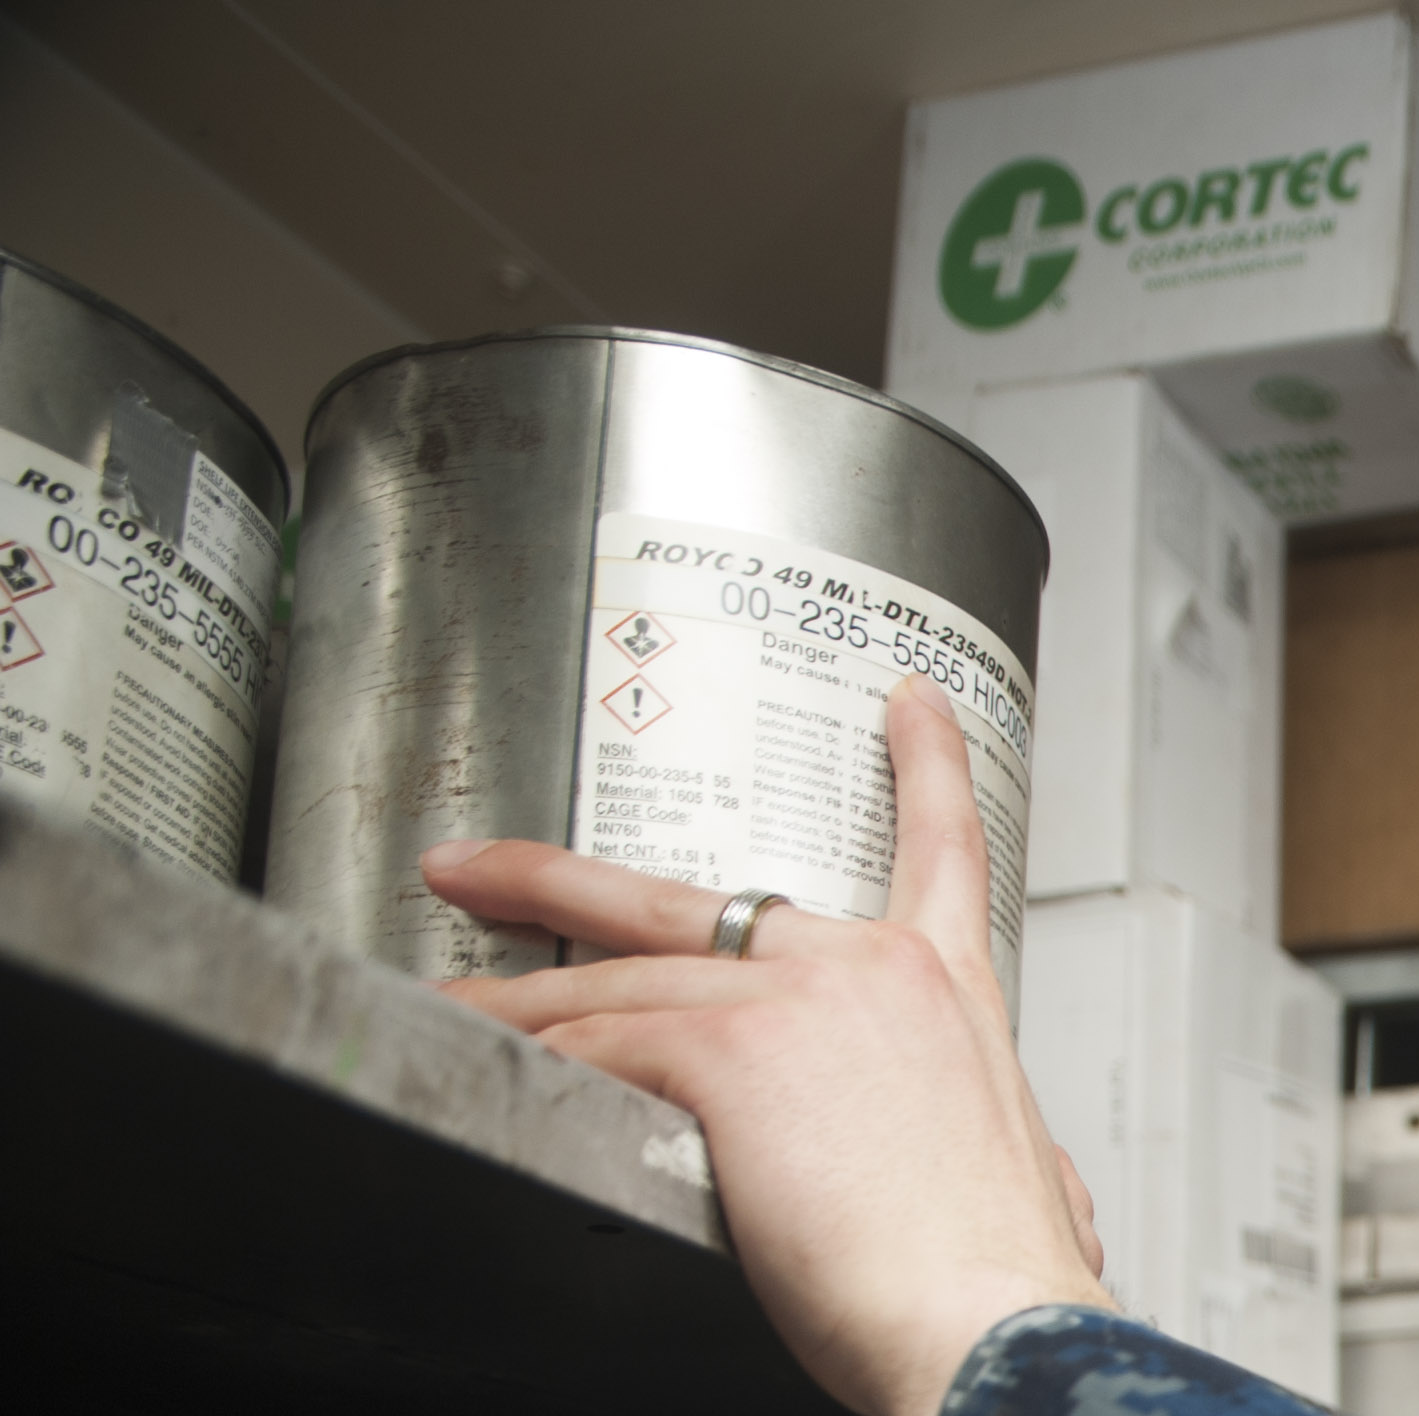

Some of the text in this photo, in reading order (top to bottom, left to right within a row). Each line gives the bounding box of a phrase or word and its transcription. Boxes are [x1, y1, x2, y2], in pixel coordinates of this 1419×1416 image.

[1096, 141, 1370, 243] CORTEC
[18, 469, 139, 541] ROCO
[145, 540, 176, 567] 49
[773, 566, 812, 589] 49
[48, 515, 244, 682] 00-235-5555
[124, 624, 148, 651] May
[150, 645, 182, 673] cause
[762, 631, 838, 665] Danger
[721, 581, 1027, 758] 00-235-5555 HIC003
[760, 654, 889, 703] May cause alle
[757, 699, 866, 736] PRECAUTIONY
[598, 742, 637, 758] NSN:
[596, 782, 662, 800] Material:
[597, 763, 731, 788] 9150-00-235-555
[595, 801, 693, 824] CAGE Code:
[753, 780, 815, 802] Response
[826, 797, 859, 815] FIRT
[593, 822, 642, 837] 4N760
[592, 842, 618, 856] Net
